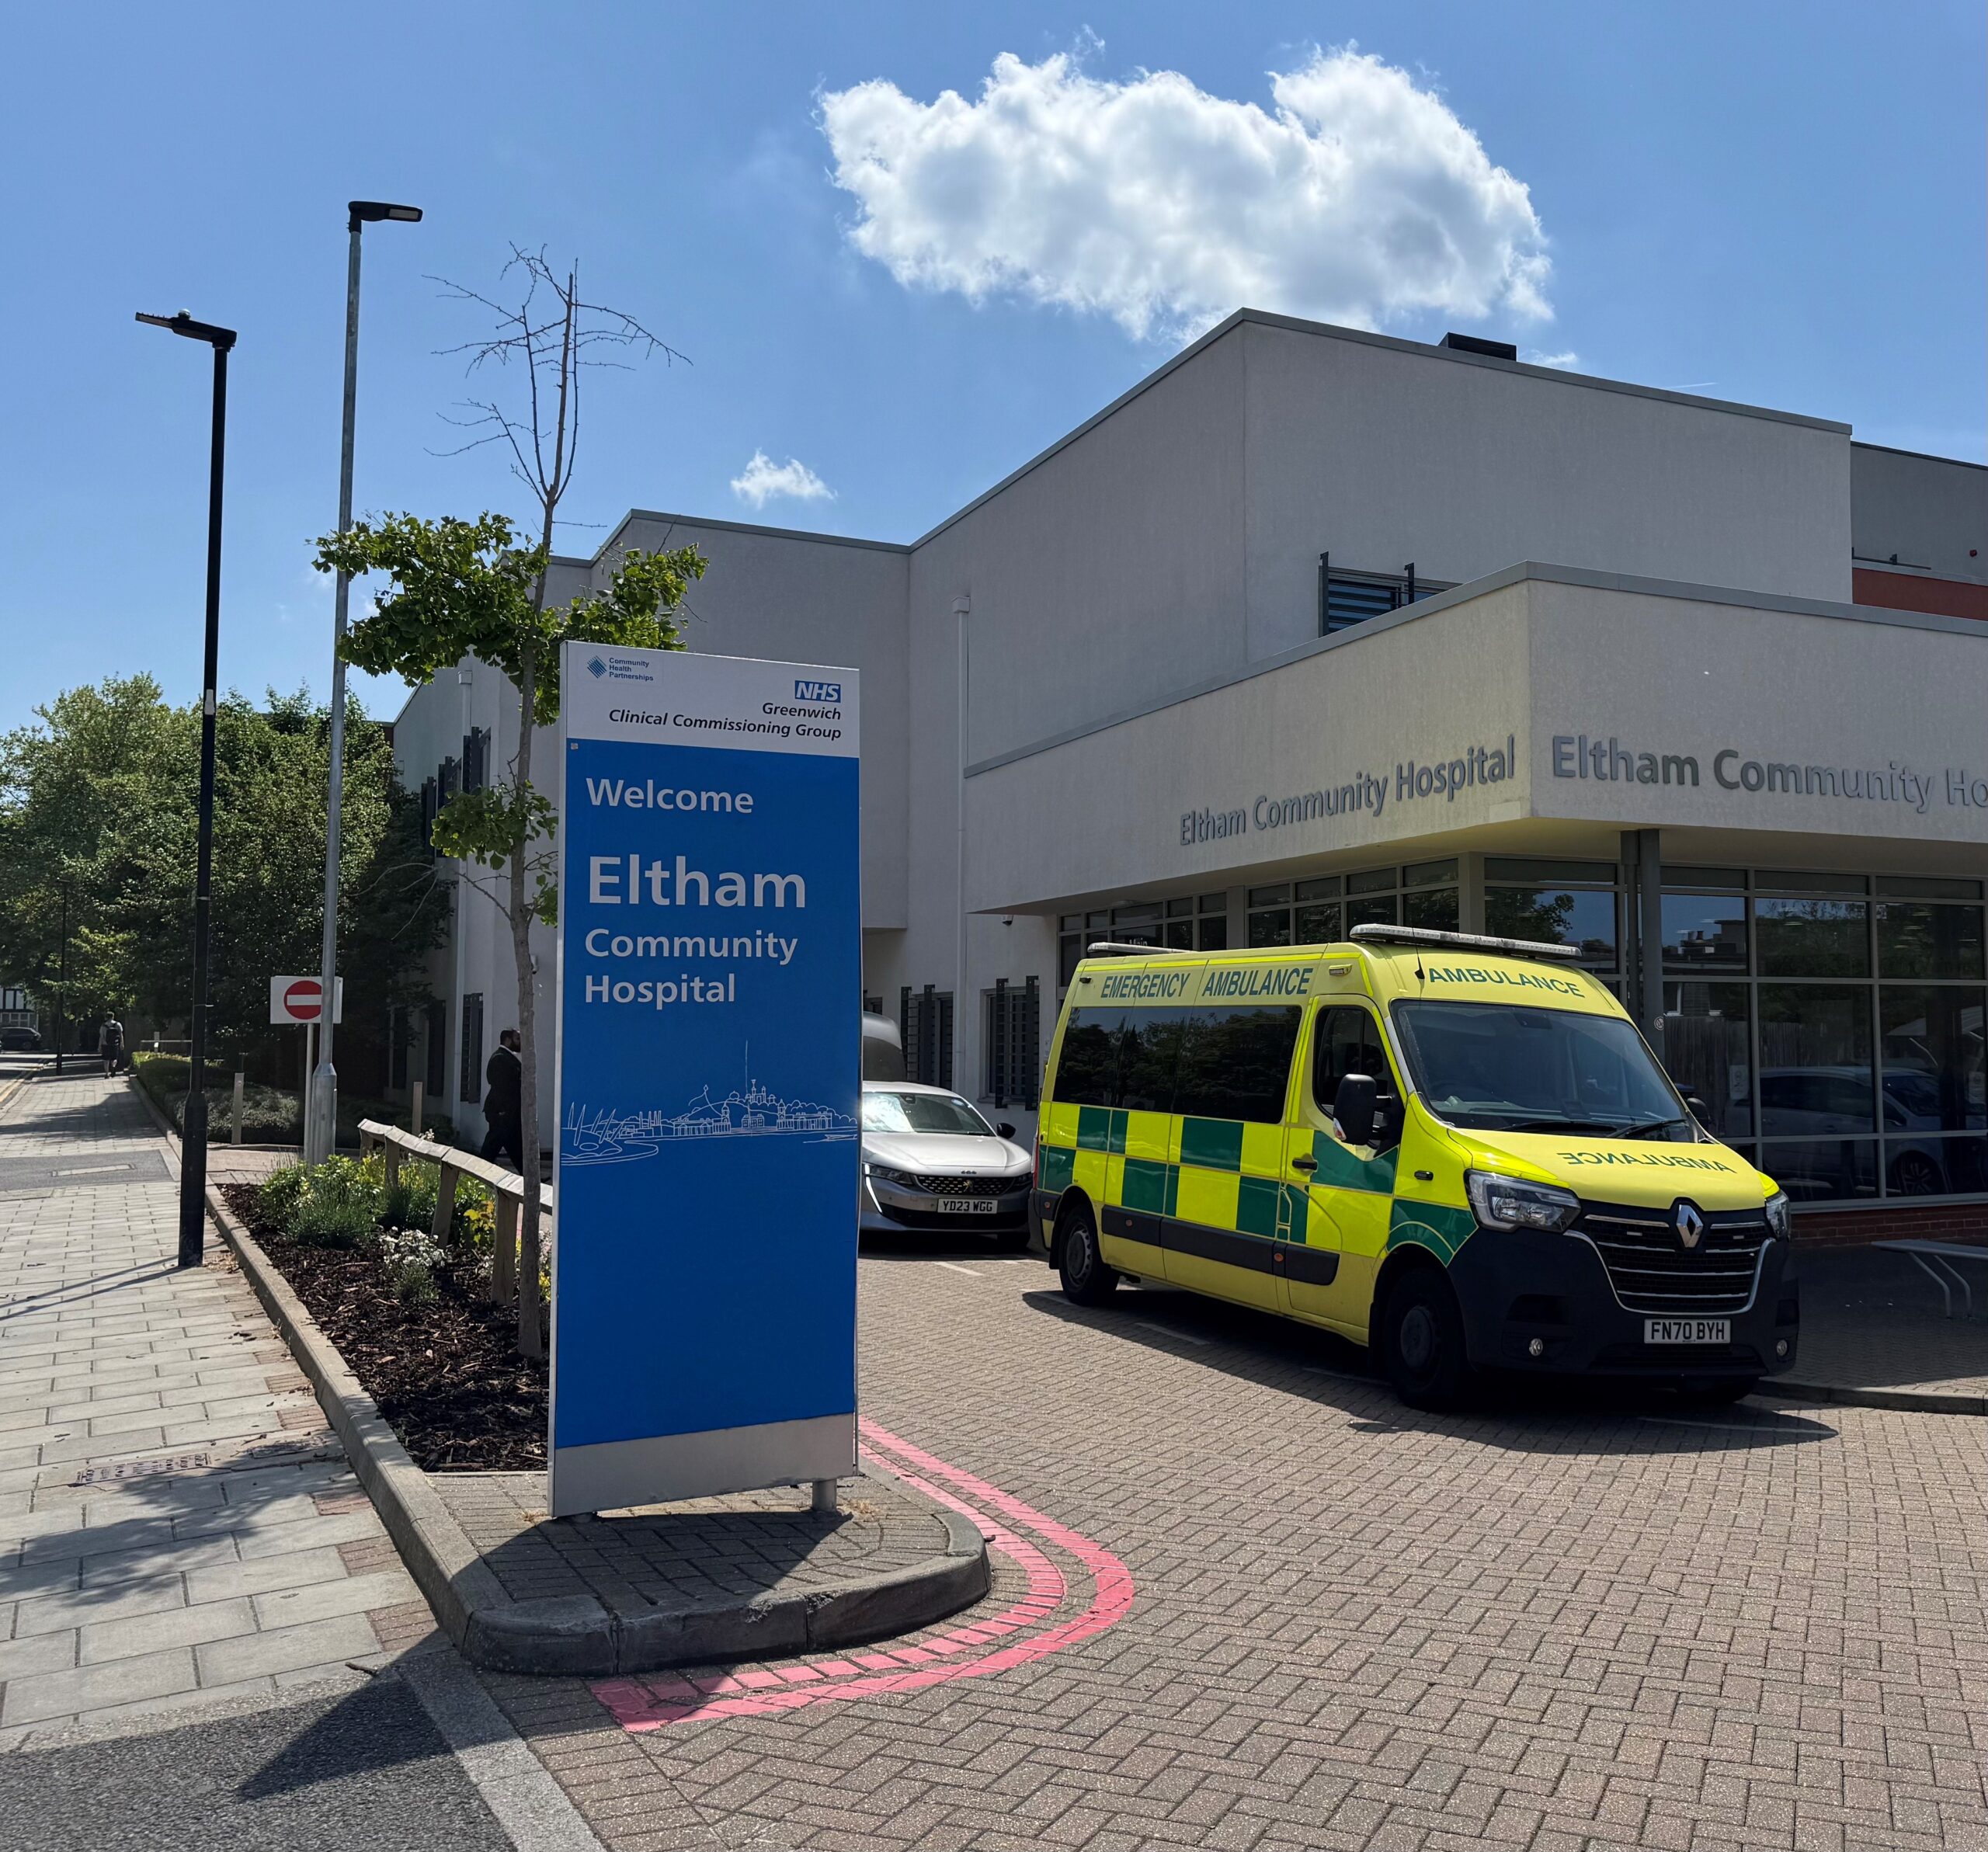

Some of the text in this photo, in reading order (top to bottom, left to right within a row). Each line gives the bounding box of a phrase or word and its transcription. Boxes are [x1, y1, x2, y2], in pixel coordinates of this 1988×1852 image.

[609, 657, 649, 668] Community
[609, 672, 654, 682] Partnerships
[795, 682, 839, 701] NHS
[609, 709, 842, 741] Clinical Commissioning Group
[762, 702, 841, 720] Greenwich
[1180, 734, 1515, 846] Eltham Community Hospital
[1552, 735, 1700, 787] Eltham
[1713, 749, 1932, 814] Community
[586, 777, 754, 814] Welcome
[589, 853, 806, 908] Eltham
[585, 929, 798, 965] Community
[585, 973, 735, 1010] Hospital
[1100, 968, 1313, 999] EMERGENCY AMBULANCE
[1428, 968, 1586, 999] AMBULANCE
[943, 1200, 992, 1212] YD23 WGG
[1651, 1322, 1725, 1340] FN70 BYH
